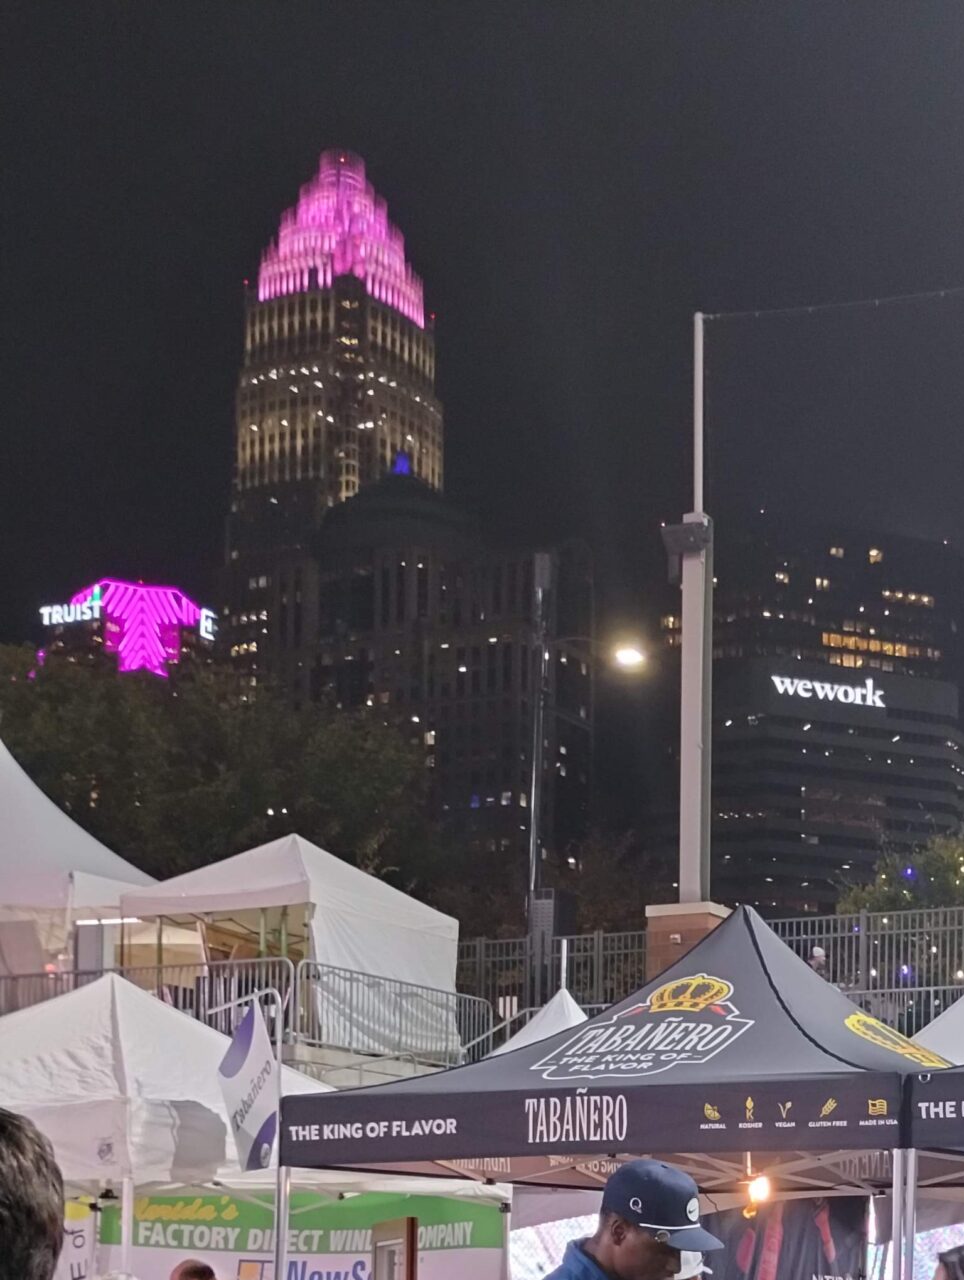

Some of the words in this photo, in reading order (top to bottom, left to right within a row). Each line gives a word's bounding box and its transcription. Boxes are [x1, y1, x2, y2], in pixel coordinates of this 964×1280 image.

[39, 600, 105, 626] TRUIST
[770, 675, 886, 708] wework
[565, 1017, 733, 1056] TABAÑERO
[560, 1055, 600, 1065] THE
[601, 1052, 656, 1062] KING
[660, 1052, 692, 1061] OF
[569, 1061, 653, 1072] FLAVOR
[525, 1087, 628, 1144] TABAÑERO
[918, 1100, 958, 1120] THE
[289, 1125, 320, 1141] THE
[323, 1123, 364, 1140] KING
[366, 1121, 389, 1138] OF
[391, 1118, 457, 1137] FLAVOR
[138, 1222, 241, 1249] FACTORY
[247, 1228, 324, 1251] DIECT
[330, 1230, 373, 1251] WIN
[418, 1221, 473, 1249] OMPANY
